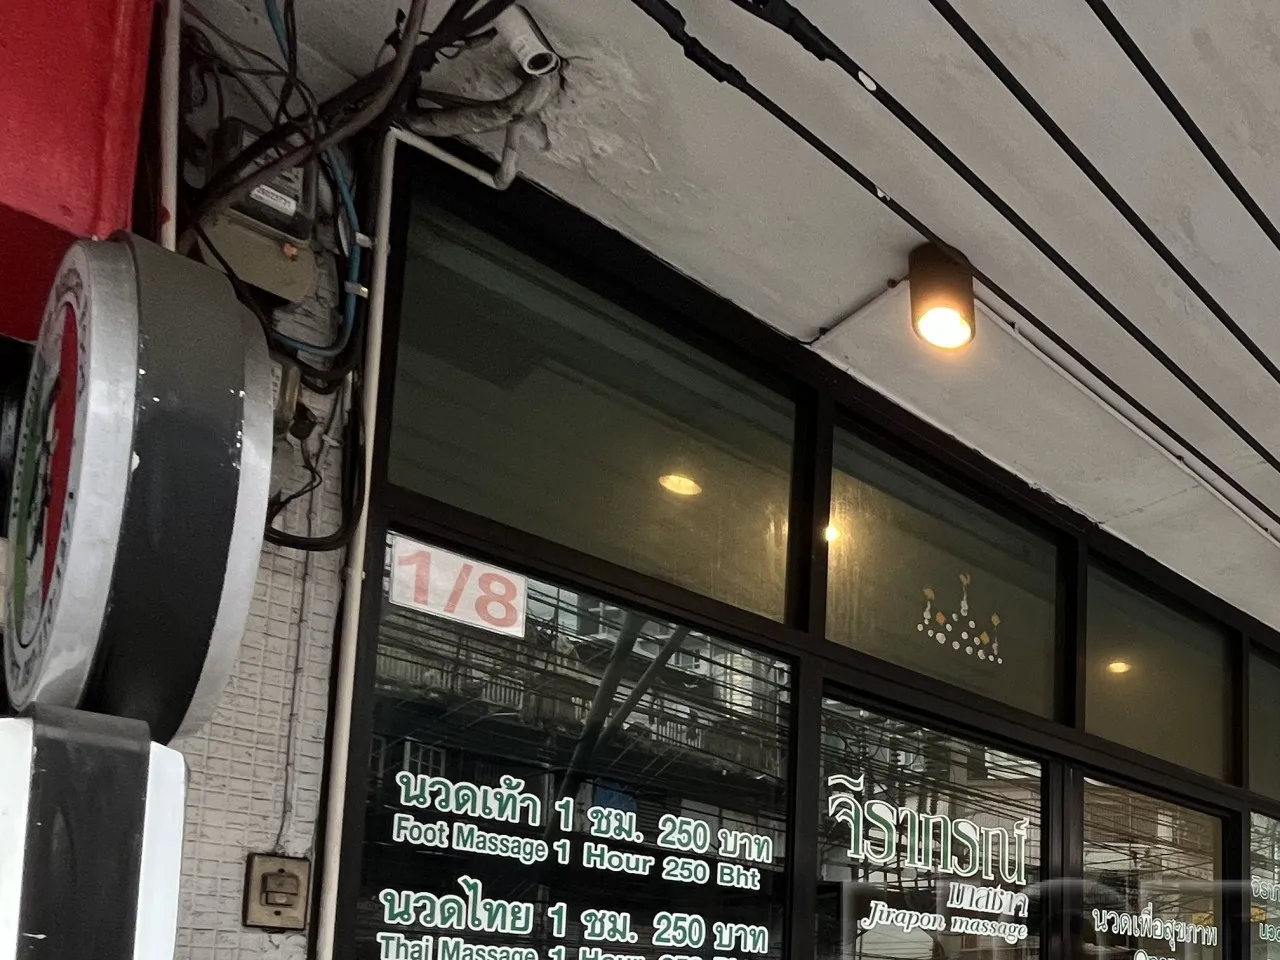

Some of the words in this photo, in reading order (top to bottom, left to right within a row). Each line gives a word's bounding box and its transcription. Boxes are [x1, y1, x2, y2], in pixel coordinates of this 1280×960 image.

[396, 548, 519, 629] 1/8
[393, 815, 448, 846] Foot
[452, 823, 548, 863] Massage
[553, 840, 570, 864] 1
[583, 843, 655, 875] Hour
[662, 859, 709, 883] 250
[717, 865, 760, 890] Bht
[396, 771, 540, 826] นวดเท้า
[555, 798, 574, 831] 1
[587, 805, 643, 842] ชม.
[658, 814, 709, 852] 250
[719, 827, 772, 862] บาท
[380, 876, 533, 934] นวดไทย
[548, 904, 566, 937] 1
[581, 908, 638, 943] ชม.
[652, 912, 705, 948] 250
[713, 921, 768, 953] บาท
[861, 901, 945, 932] Jirapon
[951, 915, 1028, 944] massage
[1092, 902, 1218, 951] นวดเพื่อสุขภาพ
